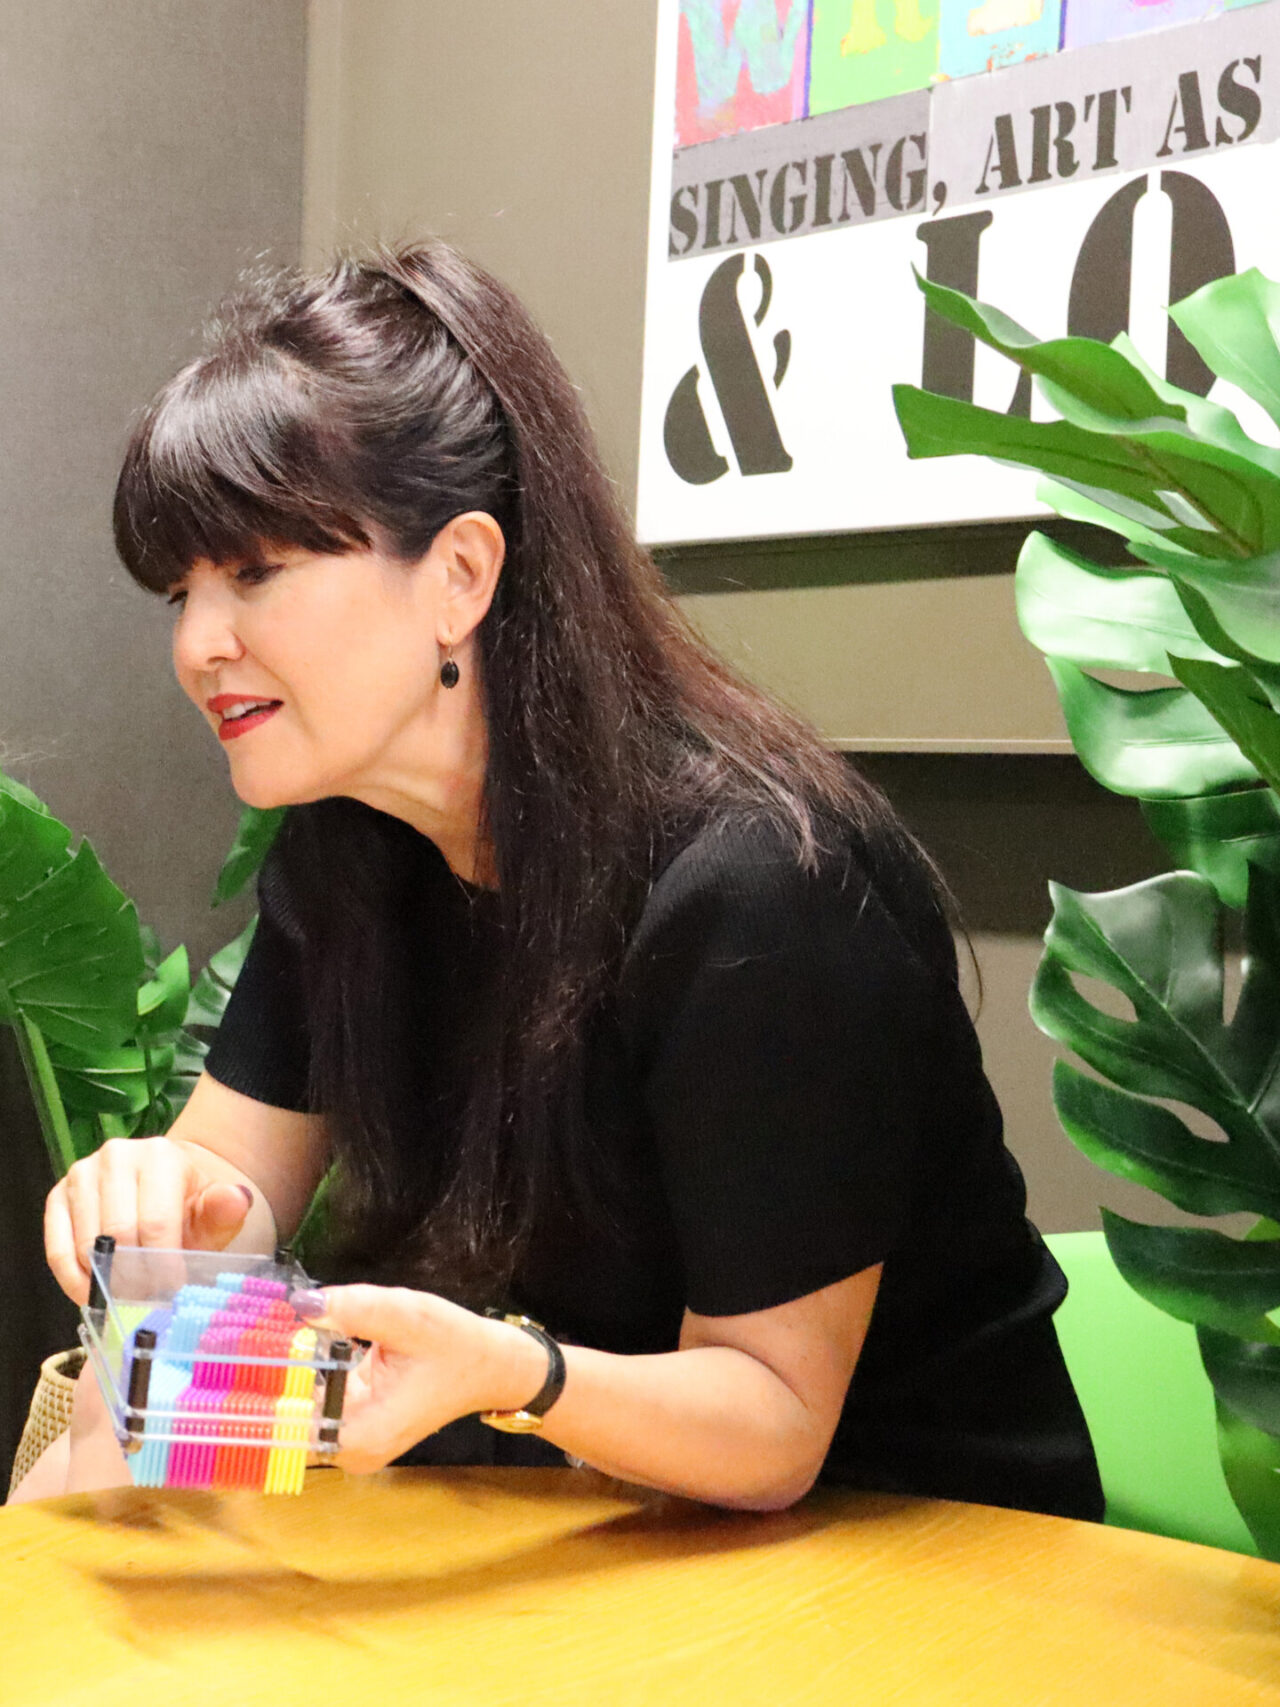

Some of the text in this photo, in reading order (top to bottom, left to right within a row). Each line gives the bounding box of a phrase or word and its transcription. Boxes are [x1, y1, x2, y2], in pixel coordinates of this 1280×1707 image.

[668, 132, 947, 255] SINGING,
[974, 85, 1132, 194] ART
[1155, 54, 1262, 158] AS
[663, 252, 794, 486] &
